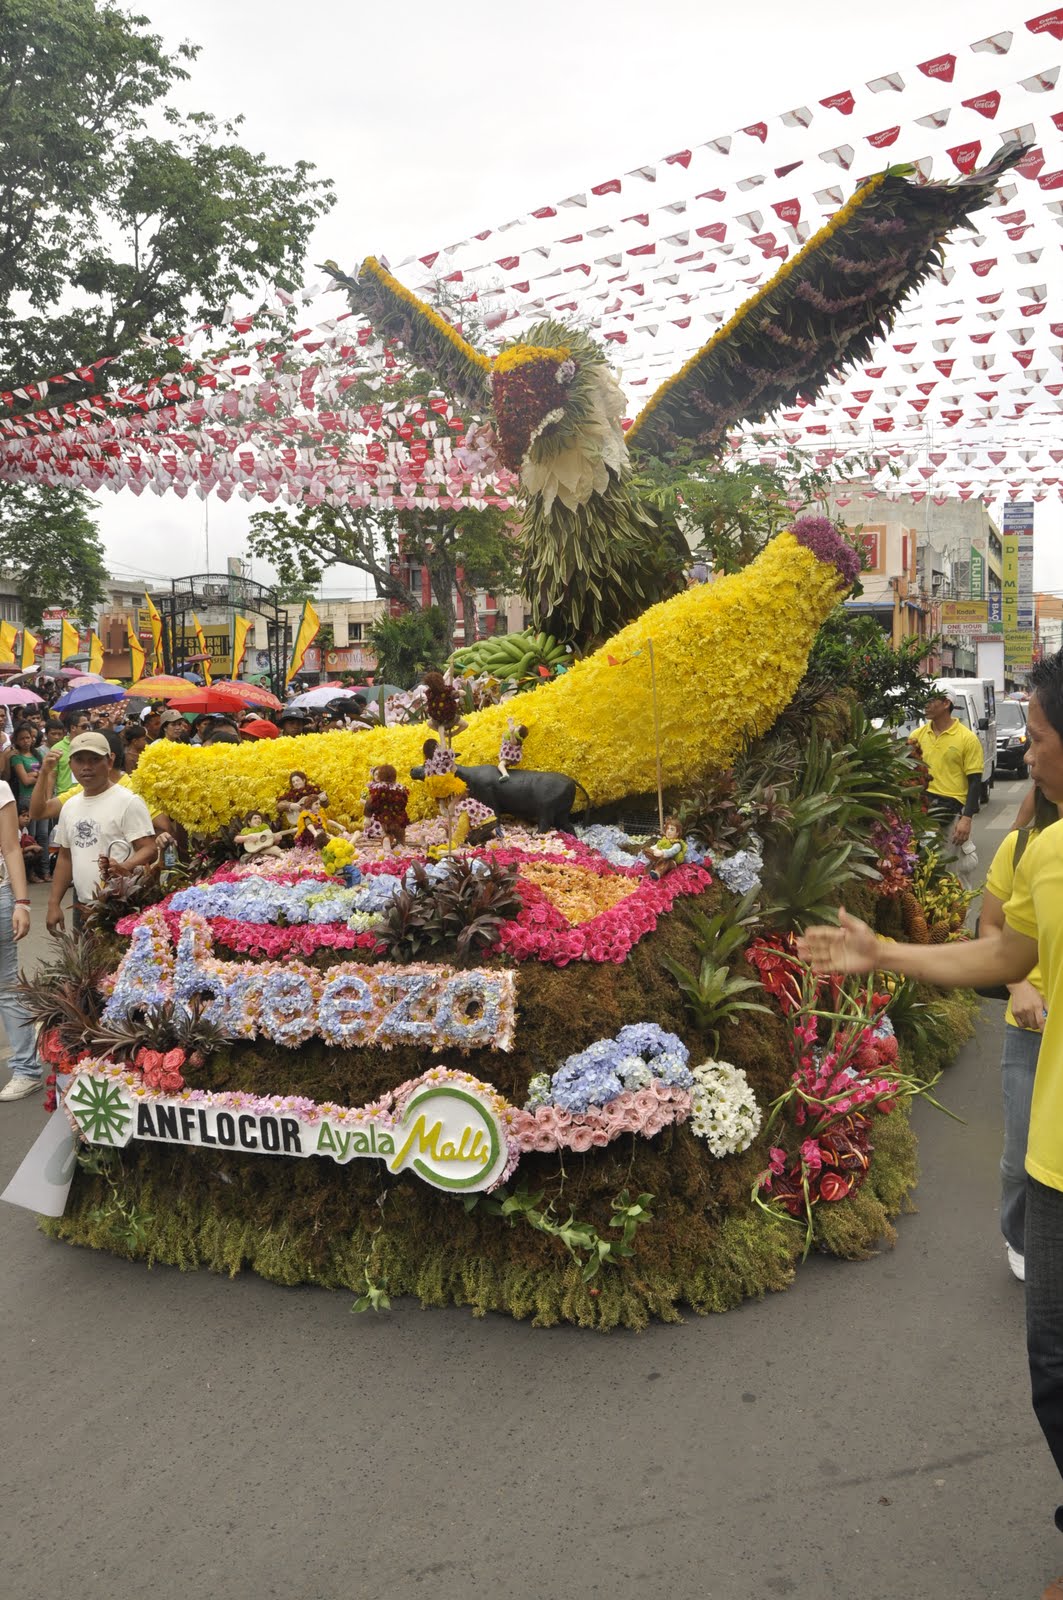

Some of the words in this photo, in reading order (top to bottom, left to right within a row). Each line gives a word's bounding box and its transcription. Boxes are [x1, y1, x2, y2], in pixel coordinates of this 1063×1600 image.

[188, 646, 221, 656] UNON
[137, 1102, 302, 1153] ANFLOCOR
[316, 1121, 396, 1161] Ayala
[390, 1114, 489, 1170] Malls
